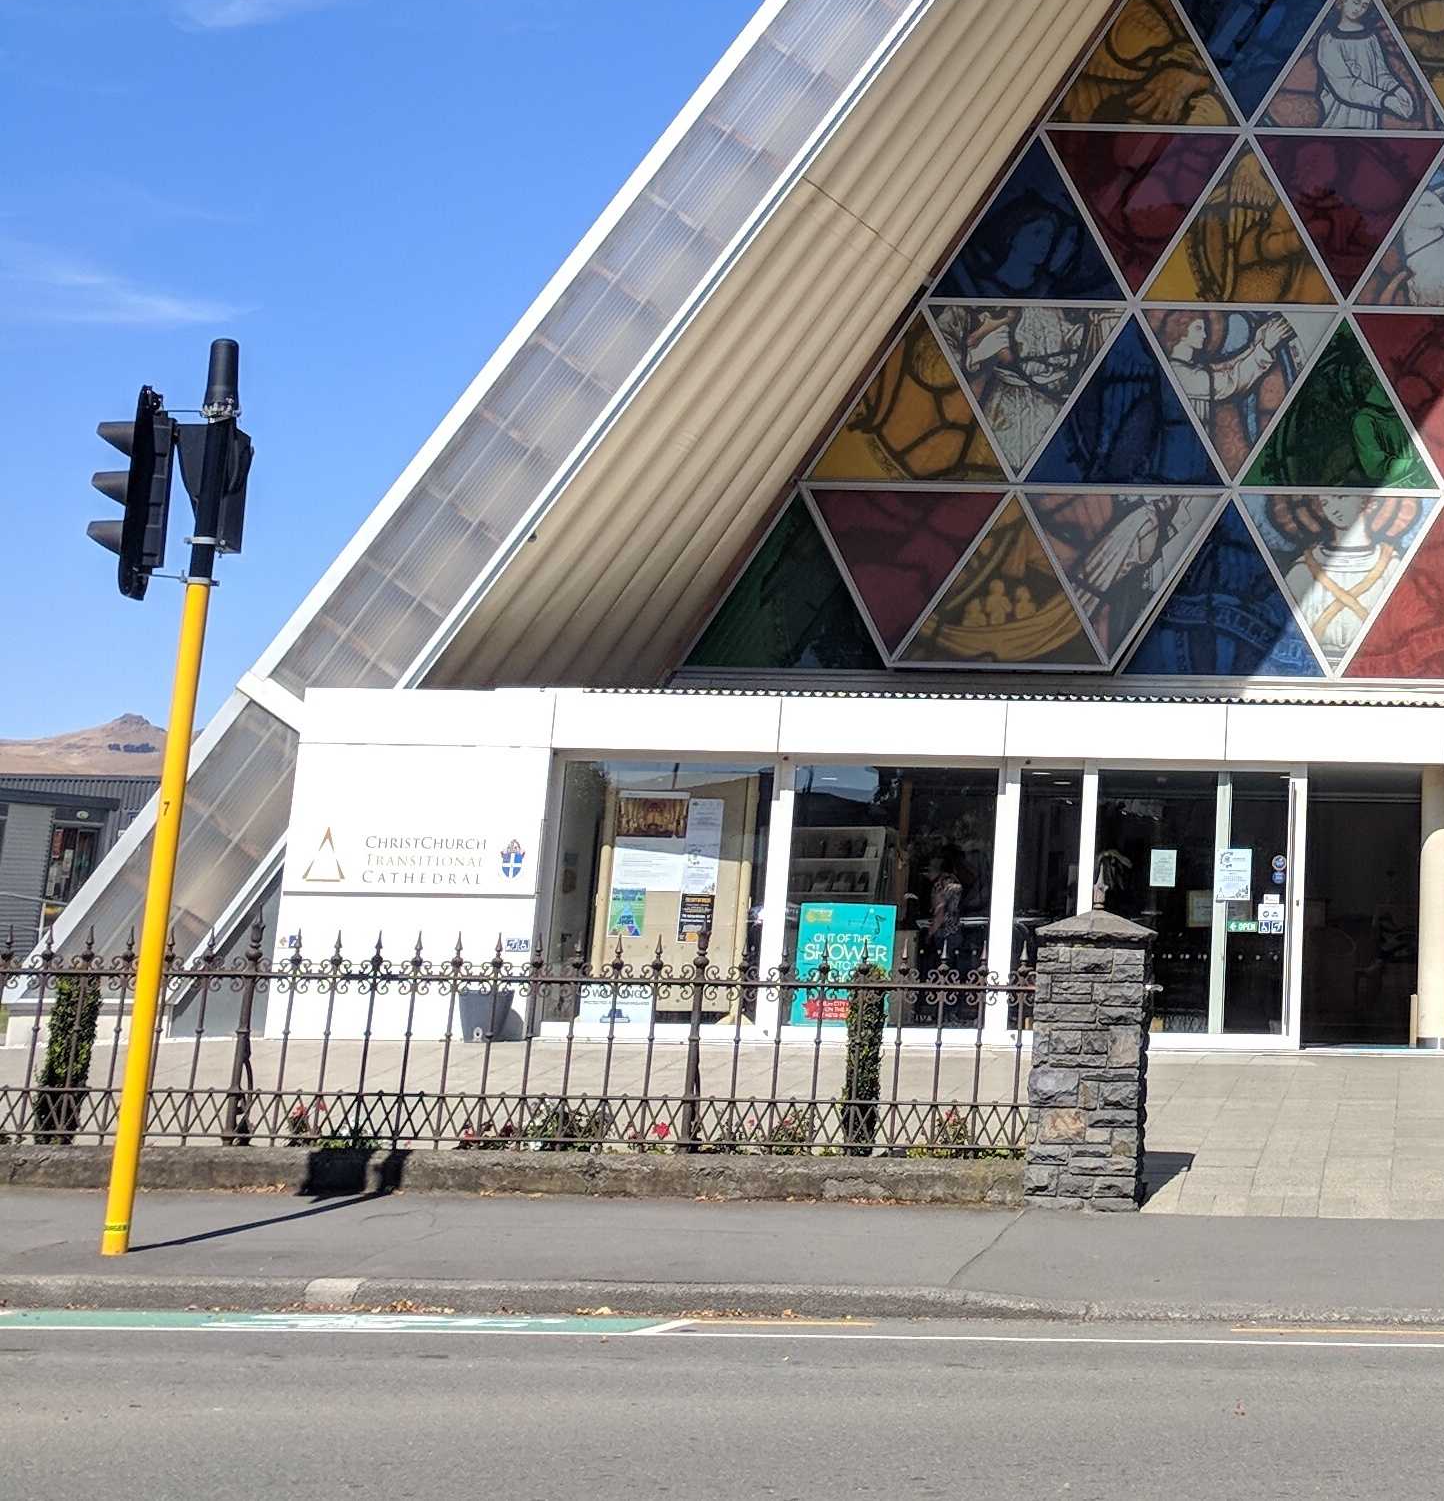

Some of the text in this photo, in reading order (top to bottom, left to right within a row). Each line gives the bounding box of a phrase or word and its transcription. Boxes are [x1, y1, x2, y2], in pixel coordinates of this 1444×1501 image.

[367, 853, 483, 868] TRANSITIONAL
[362, 869, 482, 885] CATHEDRAL
[1238, 922, 1256, 931] OPEN
[813, 933, 873, 944] OUT OF THE
[803, 943, 888, 962] SHOWER
